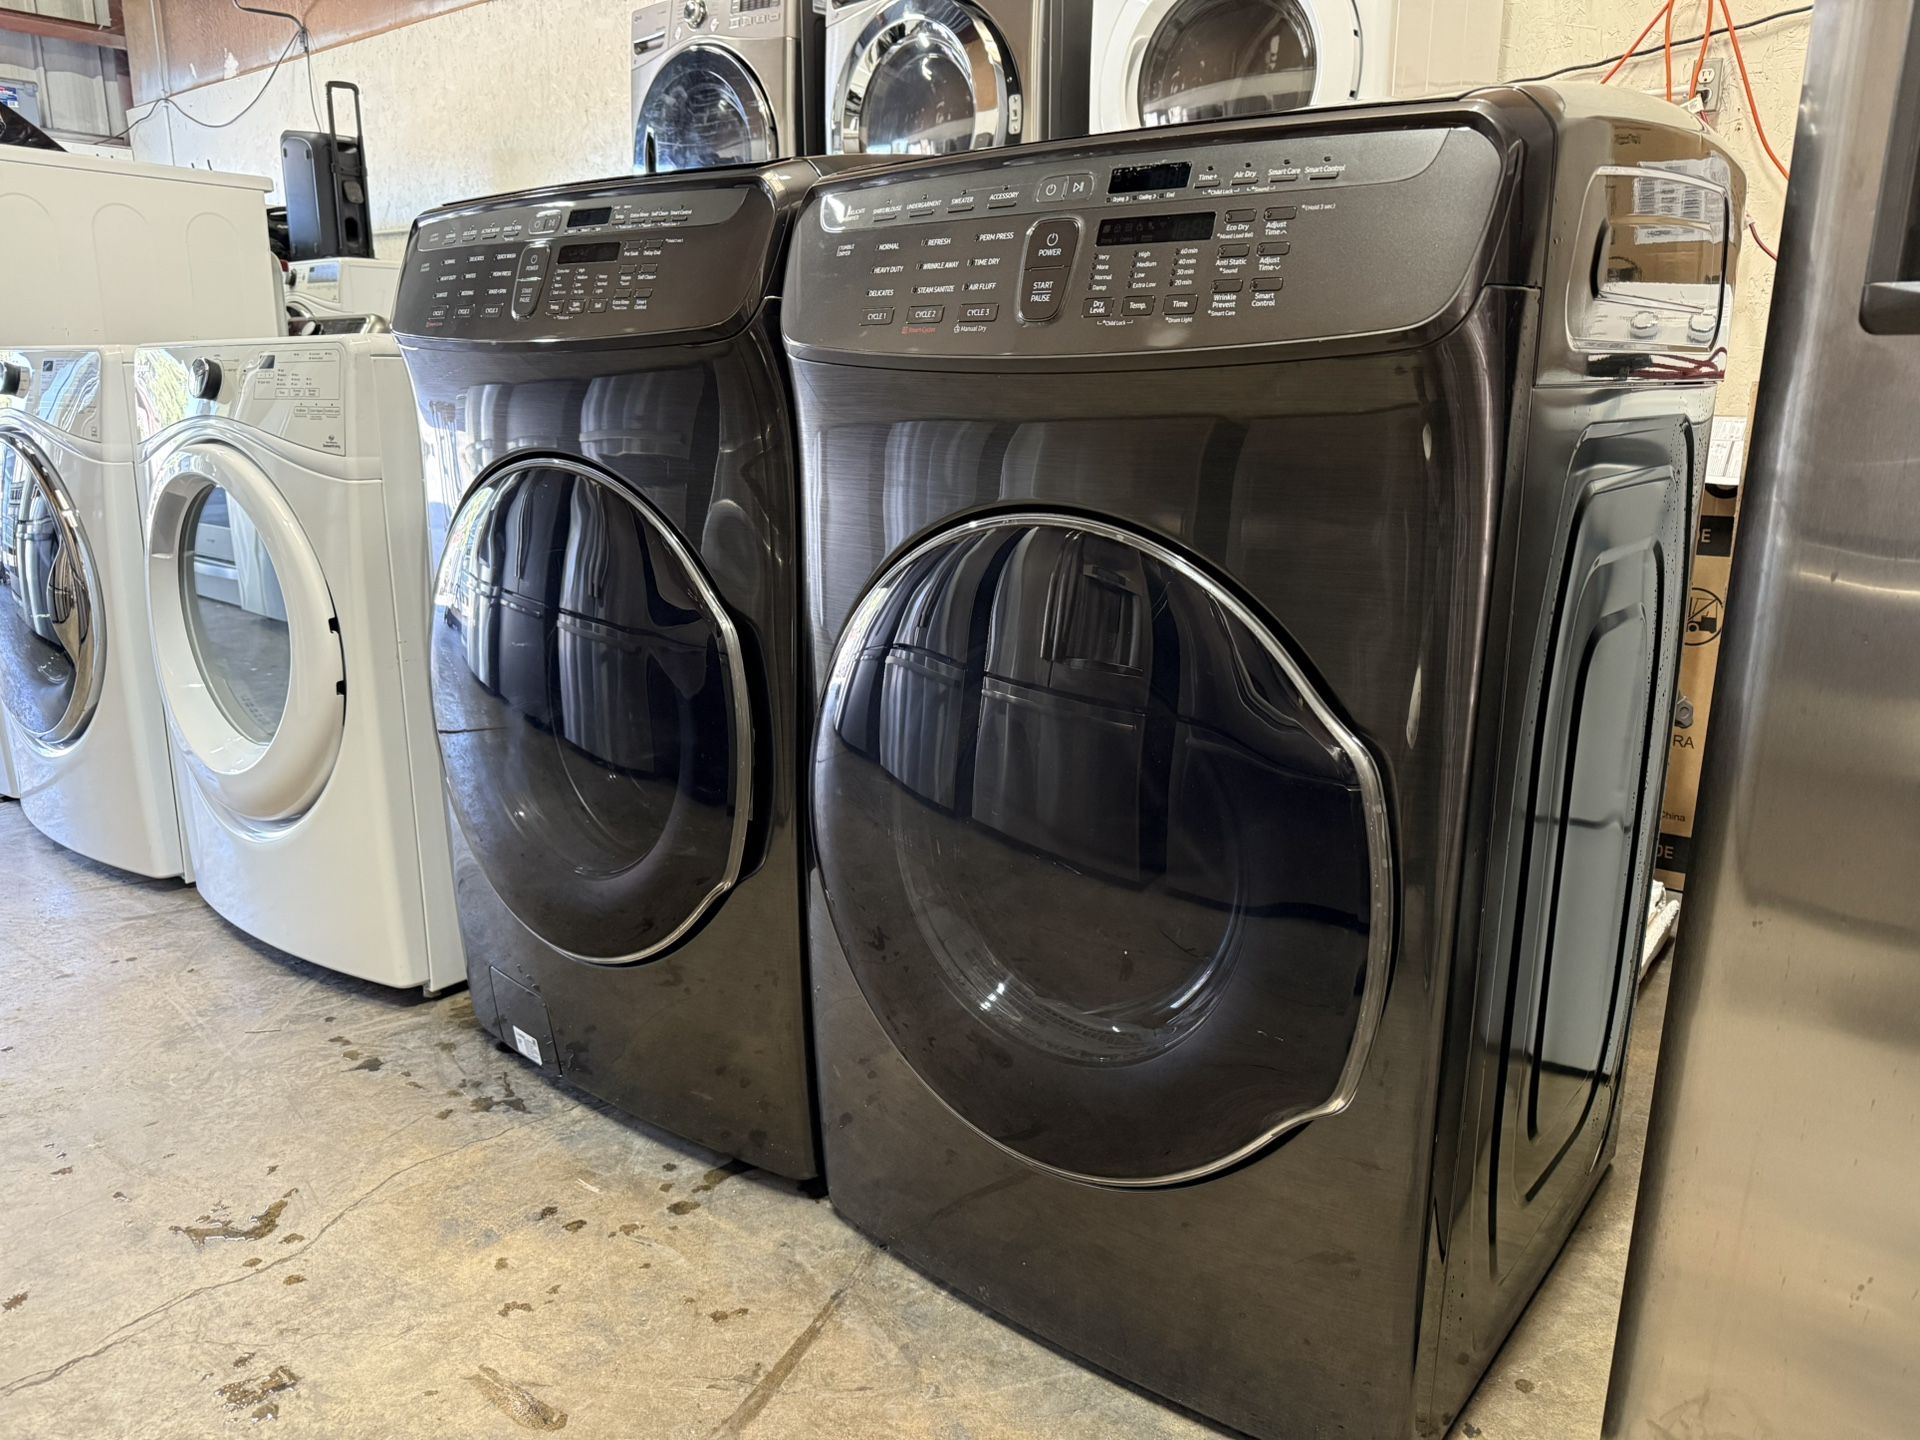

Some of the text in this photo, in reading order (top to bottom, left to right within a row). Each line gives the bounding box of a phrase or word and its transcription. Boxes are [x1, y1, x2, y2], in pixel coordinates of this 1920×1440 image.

[1268, 167, 1301, 176] Smart Care
[1305, 166, 1324, 174] Smart
[989, 192, 1019, 200] ACCESSORY
[951, 196, 974, 205] SWEATER
[906, 200, 942, 210] UNDERGARMENT
[1238, 224, 1249, 232] Dry
[1266, 221, 1287, 229] Adjust
[1265, 228, 1280, 236] Time
[979, 232, 1014, 241] PERM PRESS
[878, 242, 900, 250] NORMAL
[927, 238, 951, 246] REFRESH
[1038, 248, 1062, 256] POWER
[974, 258, 988, 266] TIME
[1259, 256, 1280, 264] Adjust
[874, 266, 890, 274] HEAVY
[923, 262, 944, 270] WRINKLE
[979, 282, 997, 290] FLUFF
[1033, 281, 1054, 289] START
[868, 289, 894, 297] DELICATES
[917, 286, 934, 294] STEAM
[1031, 294, 1051, 302] PAUSE
[1093, 300, 1104, 308] Dry
[1129, 302, 1146, 310] Temp.
[1173, 300, 1188, 308] Time
[931, 310, 936, 318] 2
[985, 308, 990, 316] 3
[978, 325, 988, 333] Dry
